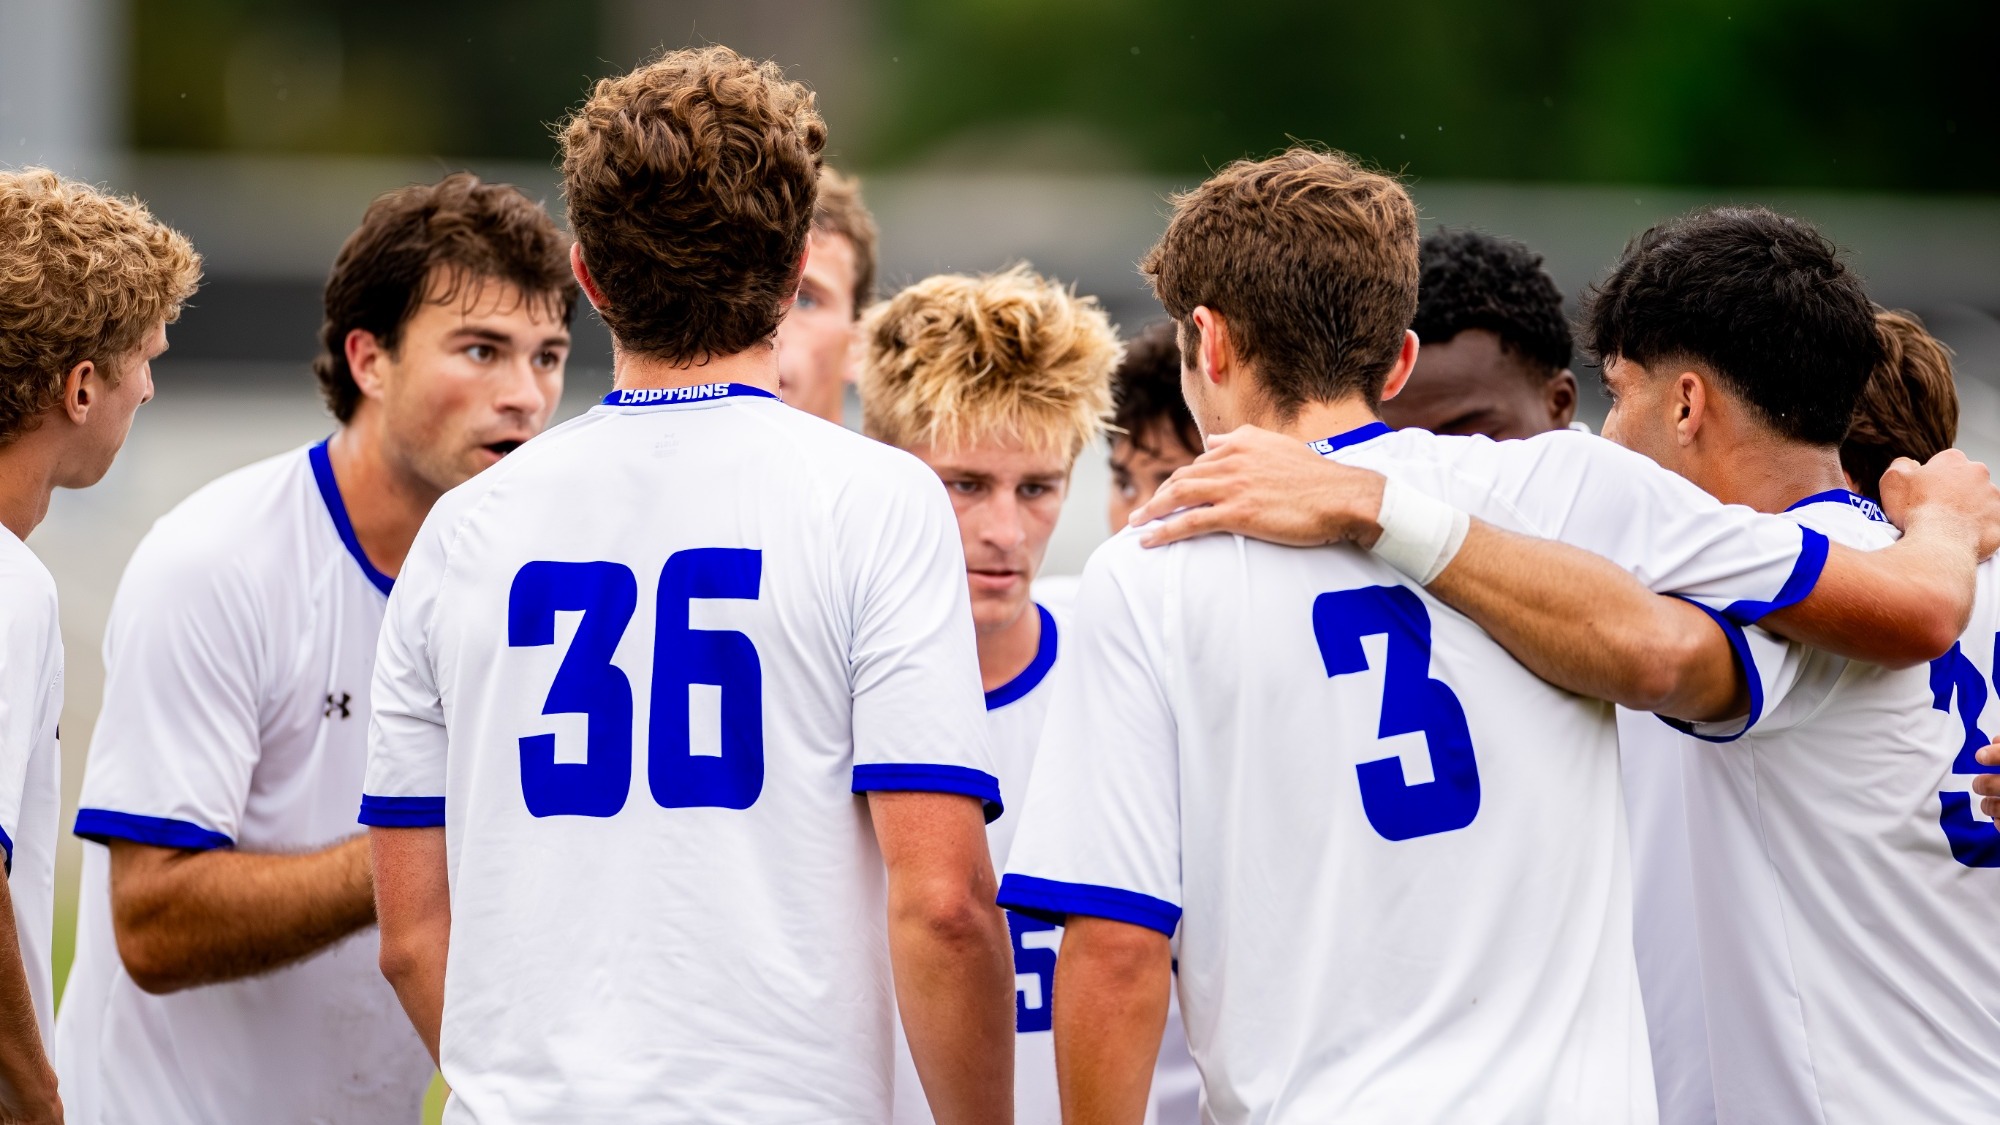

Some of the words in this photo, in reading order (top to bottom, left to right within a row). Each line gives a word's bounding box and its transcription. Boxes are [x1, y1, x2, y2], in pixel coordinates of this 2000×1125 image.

[619, 383, 730, 404] CAPTAINS
[508, 547, 764, 818] 36
[1312, 584, 1481, 842] 3
[1929, 629, 2000, 868] 3
